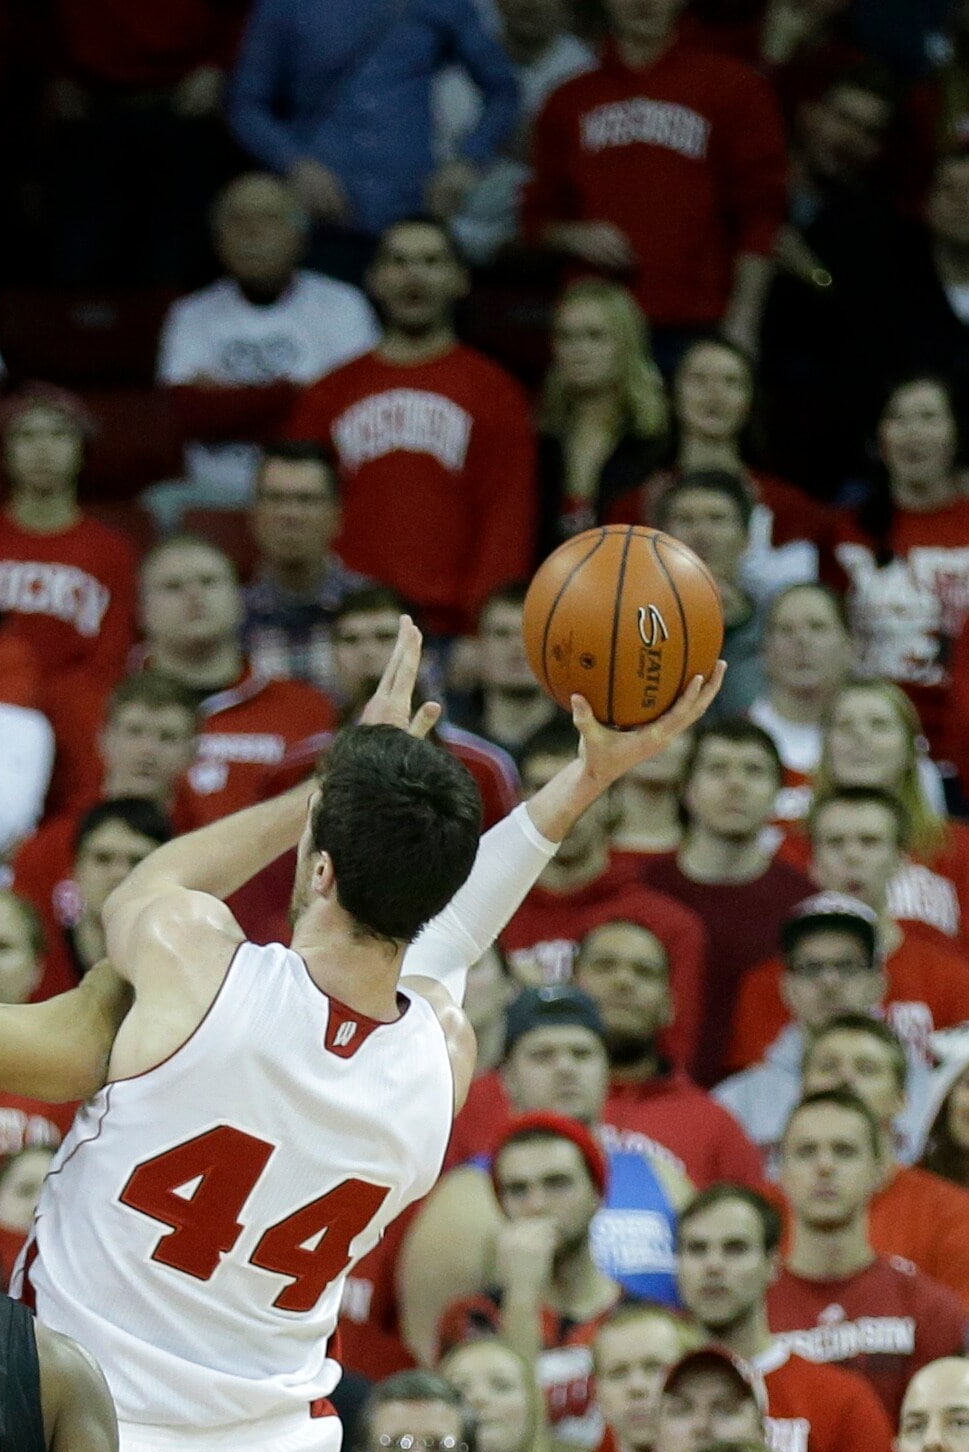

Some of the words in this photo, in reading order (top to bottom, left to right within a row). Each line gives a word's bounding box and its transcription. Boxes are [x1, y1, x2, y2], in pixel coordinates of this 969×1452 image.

[330, 387, 475, 476] WISCONSIN
[638, 603, 669, 708] STATUS
[118, 1124, 393, 1312] 44
